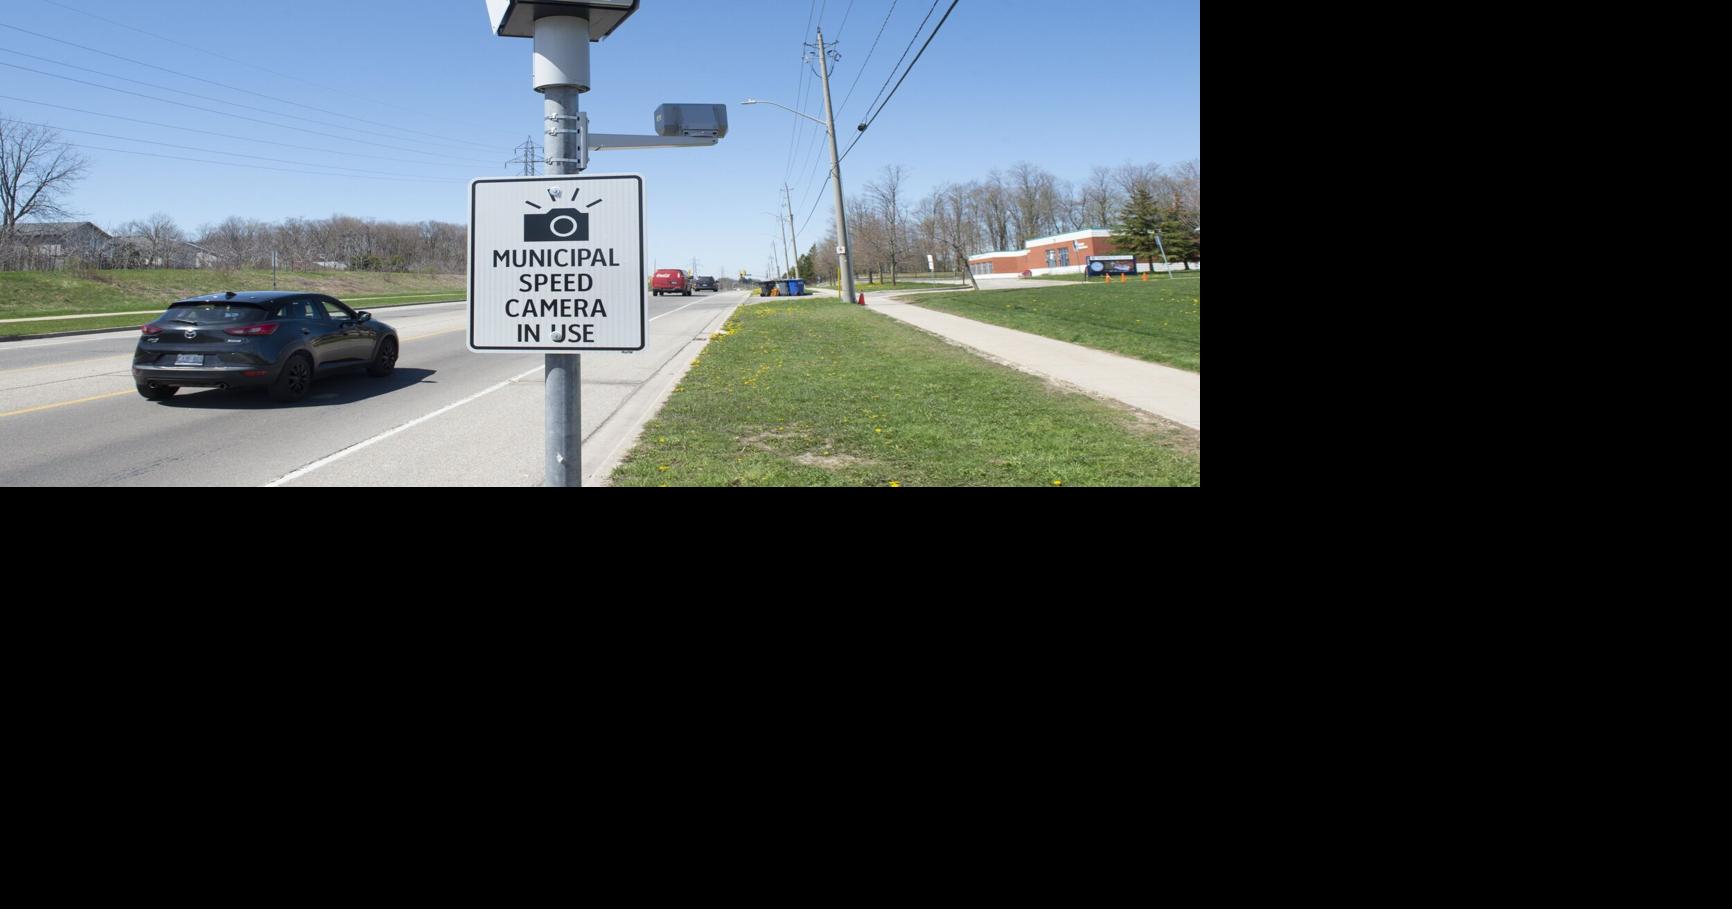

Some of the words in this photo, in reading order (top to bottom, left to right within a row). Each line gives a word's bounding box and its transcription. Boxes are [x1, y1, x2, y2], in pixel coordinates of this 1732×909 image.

[492, 248, 620, 268] MUNICIPAL
[519, 273, 593, 292] SPEED
[505, 299, 607, 318] CAMERA
[517, 324, 540, 343] IN
[551, 323, 595, 343] USE
